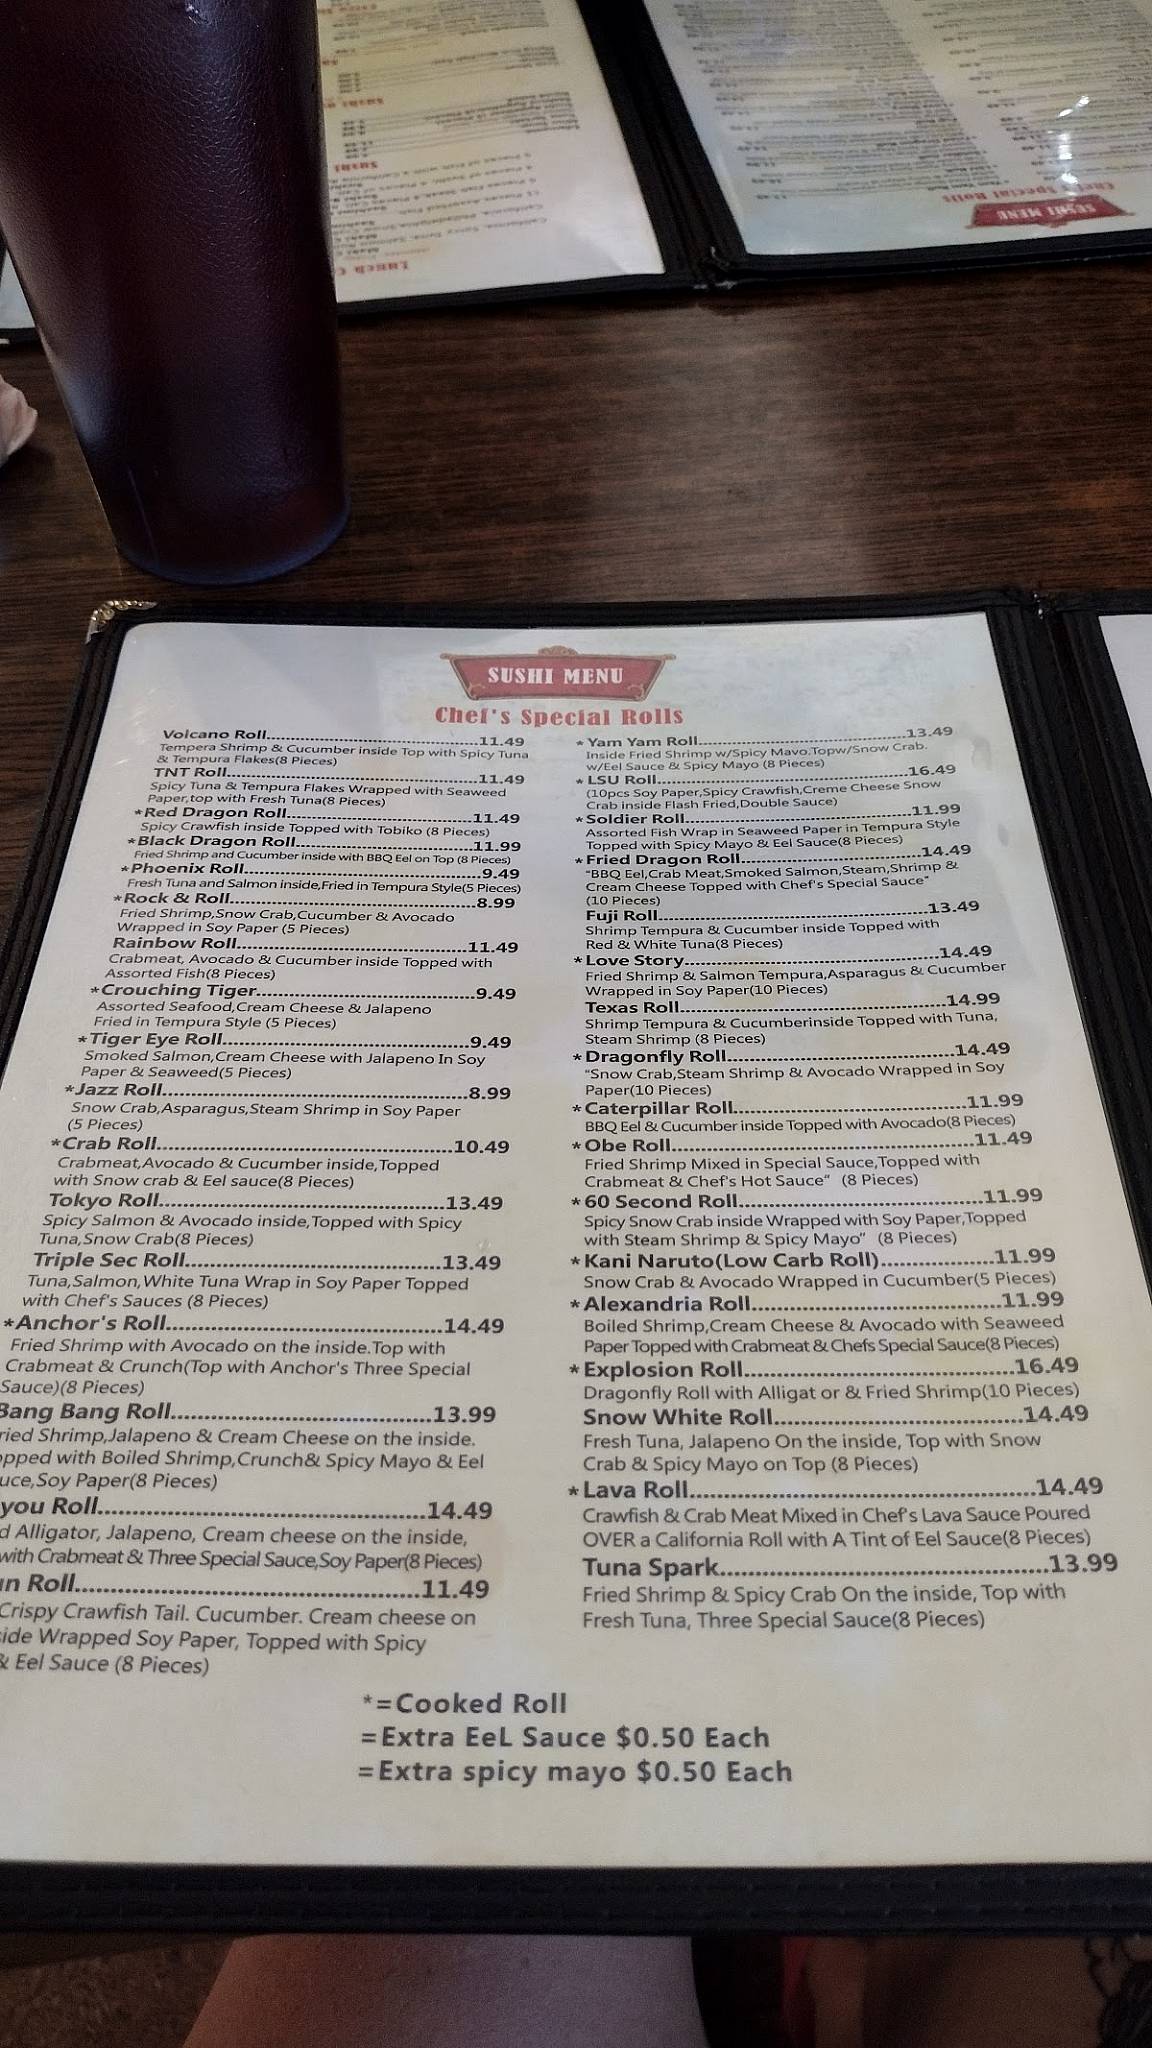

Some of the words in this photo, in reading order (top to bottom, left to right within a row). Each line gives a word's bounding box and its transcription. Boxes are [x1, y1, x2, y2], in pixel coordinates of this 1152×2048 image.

[488, 668, 552, 684] SUSHI
[564, 668, 622, 684] MENU
[436, 707, 510, 724] Chef's
[522, 710, 610, 727] Special
[622, 708, 683, 725] Rolls
[164, 730, 229, 739] Volcano
[235, 730, 266, 739] Roll
[480, 737, 524, 746] 11.49
[588, 738, 622, 747] Yam
[627, 738, 661, 746] Yam
[667, 736, 697, 746] Roll
[907, 727, 952, 738] 13.49
[154, 768, 190, 777] TNT
[194, 767, 226, 777] Roll
[479, 774, 524, 784] 11.49
[588, 776, 619, 784] LSU
[625, 775, 656, 784] Roll
[908, 765, 956, 776] 16.49
[144, 807, 178, 817] Red
[183, 807, 247, 820] Dragon
[254, 808, 286, 818] Roll
[474, 814, 520, 823] 11.49
[586, 814, 647, 824] Soldier
[653, 814, 684, 823] Roll
[912, 804, 960, 816] 11.99
[138, 835, 185, 846] Black
[190, 836, 256, 848] Dragon
[262, 837, 295, 847] Roll
[474, 842, 520, 851] 11.99
[587, 854, 630, 864] Fried
[636, 855, 701, 867] Dragon
[707, 853, 740, 864] Roll
[922, 845, 971, 857] 14.49
[131, 863, 205, 873] Phoenix
[210, 863, 244, 874] Roll
[483, 869, 519, 879] 9.49
[124, 892, 169, 903] Rock
[174, 893, 189, 903] &
[195, 893, 230, 903] Roll
[477, 898, 515, 908] 8.99
[587, 910, 618, 924] Fuji
[624, 910, 657, 921] Roll
[928, 901, 979, 914] 13.49
[113, 937, 196, 948] Rainbow
[201, 938, 236, 948] Roll
[469, 942, 518, 953] 11.49
[586, 955, 629, 966] Love
[634, 955, 684, 968] Story
[940, 945, 992, 958] 14.49
[102, 984, 201, 999] Crouching
[207, 984, 257, 999] Tiger
[477, 988, 516, 999] 9.49
[585, 1002, 638, 1013] Texas
[644, 1001, 678, 1013] Roll
[947, 993, 1000, 1006] 14.99
[90, 1032, 141, 1048] Tiger
[146, 1033, 179, 1048] Eye
[185, 1033, 222, 1045] Roll
[471, 1036, 511, 1048] 9.49
[586, 1034, 632, 1044] Steam
[637, 1034, 690, 1047] Shrimp
[696, 1034, 709, 1046] (8
[714, 1034, 765, 1045] Pieces)
[586, 1050, 684, 1066] Dragonfly
[690, 1050, 726, 1062] Roll
[956, 1042, 1010, 1056] 14.49
[75, 1083, 119, 1095] Jazz
[124, 1083, 162, 1096] Roll
[469, 1087, 510, 1099] 8.99
[585, 1102, 690, 1118] Caterpillar
[696, 1101, 733, 1114] Roll
[968, 1094, 1023, 1108] 11.99
[63, 1136, 111, 1150] Crab
[117, 1137, 157, 1150] Roll
[455, 1140, 509, 1153] 10.49
[585, 1139, 626, 1152] Obe
[633, 1138, 670, 1152] Roll
[975, 1131, 1032, 1146] 11.49
[50, 1193, 112, 1211] Tokyo
[118, 1193, 159, 1207] Roll
[446, 1196, 502, 1210] 13.49
[585, 1195, 609, 1208] 60
[616, 1194, 691, 1208] Second
[699, 1194, 737, 1208] Roll
[984, 1188, 1042, 1203] 11.99
[34, 1252, 94, 1271] Triple
[100, 1253, 137, 1267] Sec
[144, 1252, 185, 1267] Roll
[443, 1256, 500, 1270] 13.49
[586, 1254, 630, 1268] Kani
[638, 1254, 767, 1270] Naruto(Low
[774, 1252, 823, 1267] Carb
[830, 1252, 878, 1270] Roll)
[995, 1248, 1055, 1264] 11.99
[584, 1296, 702, 1311] Alexandria
[710, 1296, 750, 1311] Roll
[1002, 1291, 1064, 1308] 11.99
[15, 1314, 116, 1330] Anchor's
[123, 1315, 166, 1330] Roll
[445, 1318, 504, 1334] 14.49
[585, 1361, 693, 1382] Explosion
[701, 1360, 742, 1377] Roll
[1016, 1357, 1078, 1374] 16.49
[60, 1403, 119, 1424] Bang
[126, 1402, 171, 1419] Roll
[434, 1406, 496, 1423] 13.99
[584, 1408, 646, 1425] Snow
[653, 1408, 722, 1425] White
[730, 1408, 772, 1425] Roll
[1024, 1405, 1088, 1423] 14.49
[584, 1481, 636, 1498] Lava
[644, 1480, 688, 1498] Roll
[1036, 1477, 1103, 1496] 14.49
[52, 1496, 98, 1514] Roll
[428, 1502, 492, 1519] 14.49
[582, 1558, 641, 1576] Tuna
[649, 1557, 719, 1582] Spark
[1050, 1553, 1118, 1573] 13.99
[27, 1573, 75, 1592] Roll
[422, 1580, 489, 1598] 11.49
[584, 1586, 630, 1603] Fried
[637, 1586, 705, 1607] Shrimp
[712, 1586, 729, 1602] &
[734, 1586, 785, 1607] Spicy
[791, 1586, 836, 1602] Crab
[842, 1586, 870, 1602] On
[876, 1586, 908, 1602] the
[914, 1584, 976, 1604] inside,
[981, 1584, 1018, 1604] Top
[1023, 1582, 1066, 1600] with
[514, 1693, 566, 1713] Roll
[466, 1727, 512, 1747] EeL
[523, 1726, 605, 1747] Sauce
[617, 1725, 694, 1750] $0.50
[706, 1726, 769, 1748] Each
[464, 1760, 537, 1788] spicy
[548, 1766, 625, 1788] mayo
[638, 1759, 715, 1784] $0.50
[728, 1760, 792, 1782] Each
